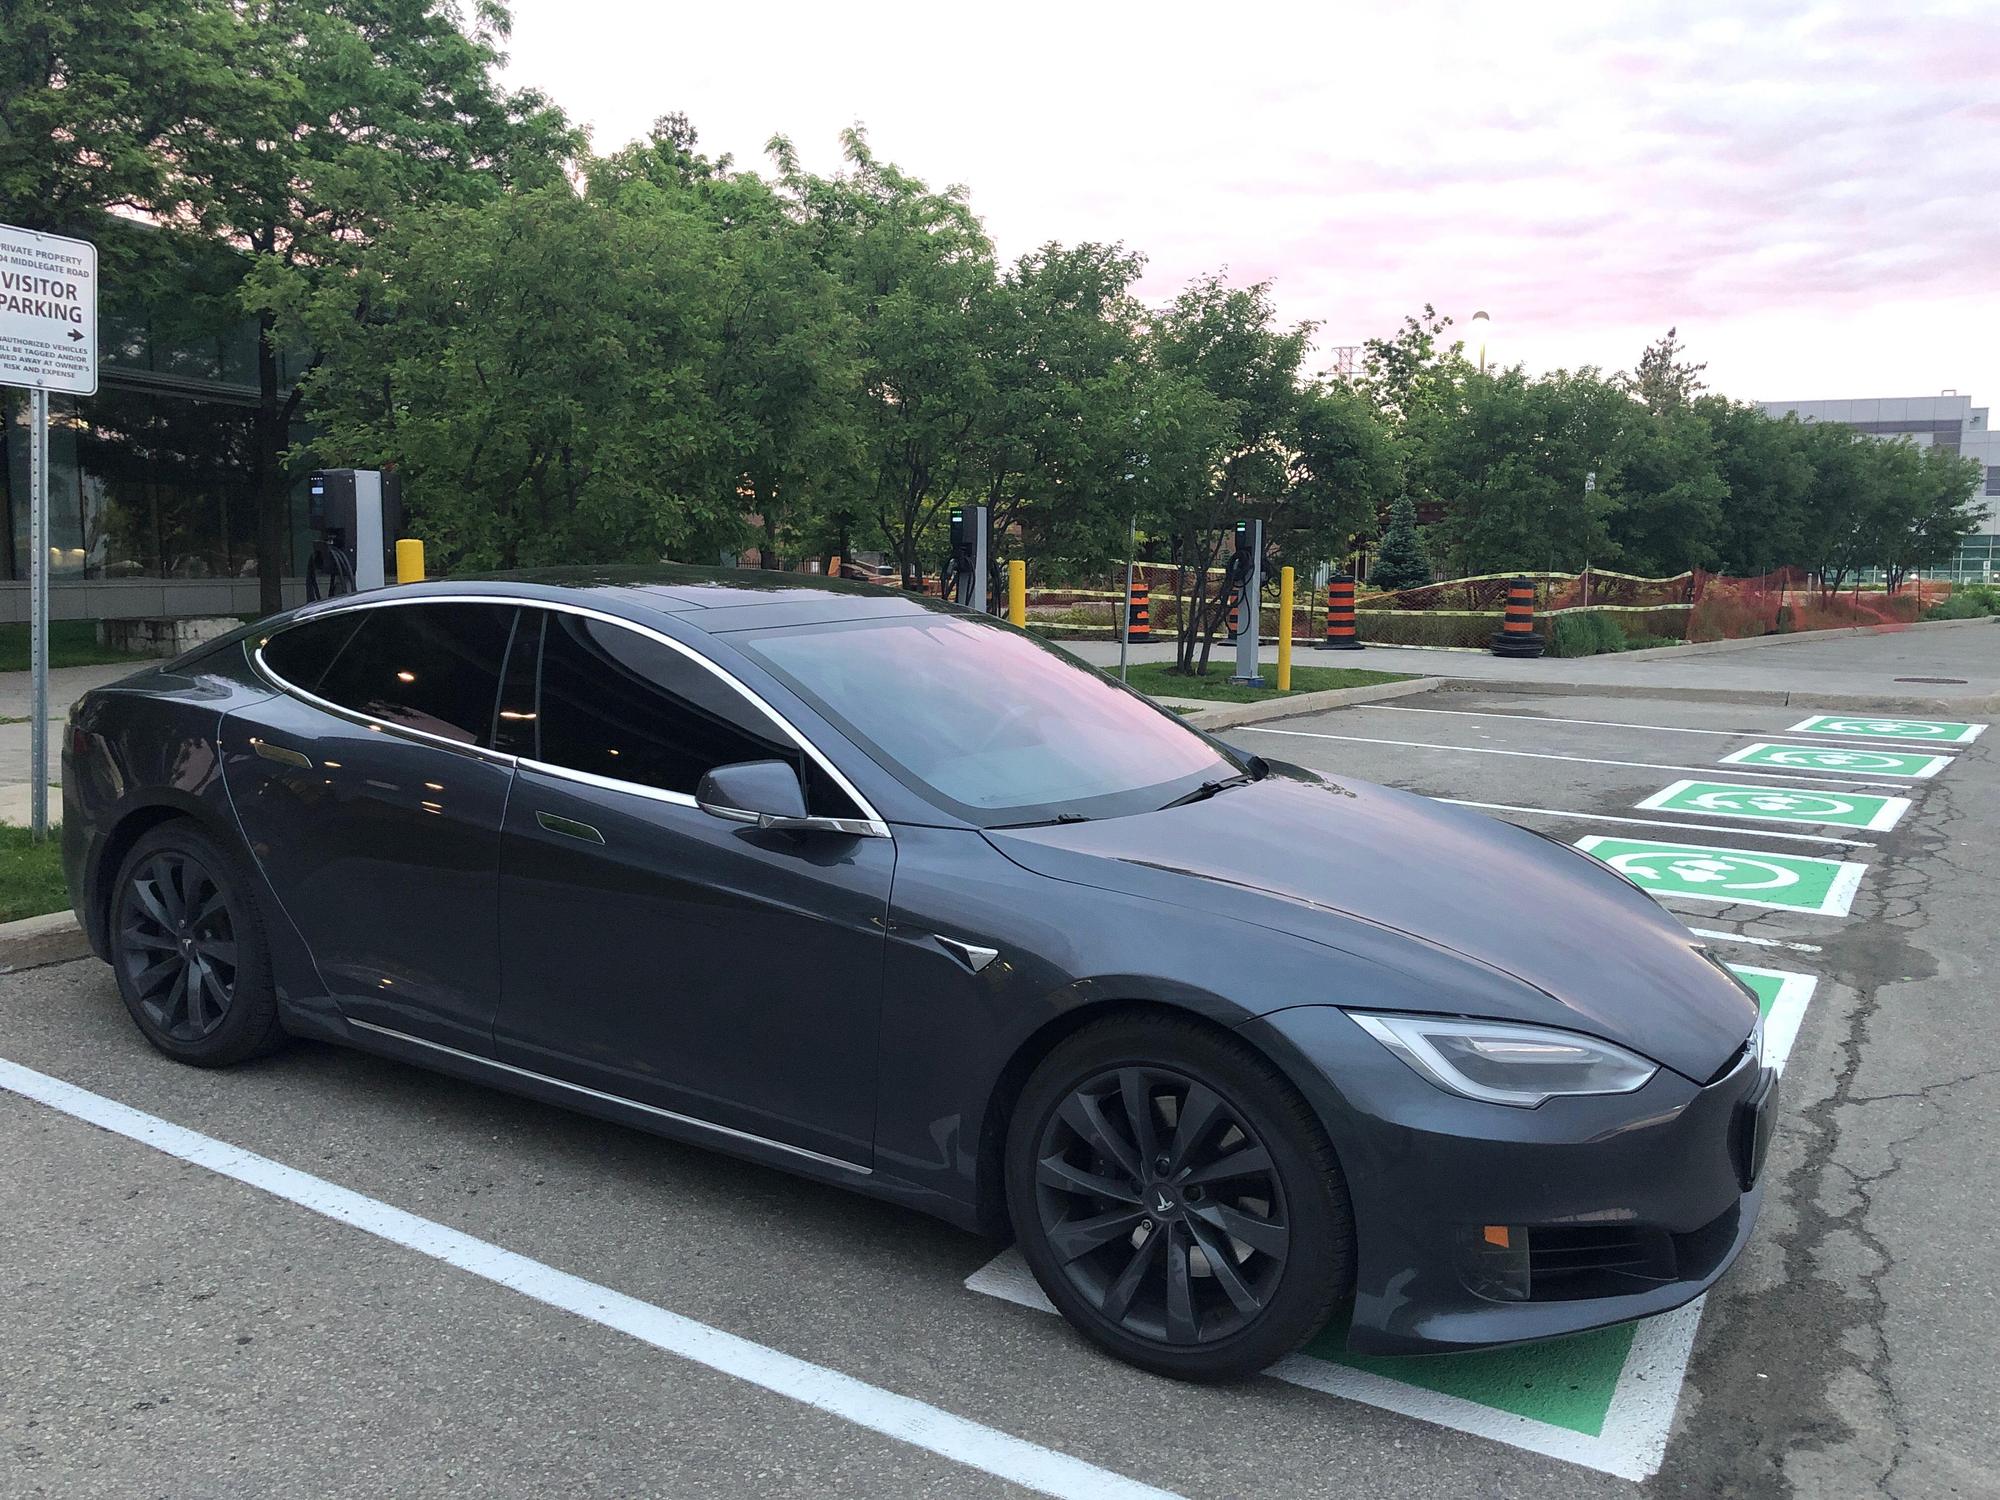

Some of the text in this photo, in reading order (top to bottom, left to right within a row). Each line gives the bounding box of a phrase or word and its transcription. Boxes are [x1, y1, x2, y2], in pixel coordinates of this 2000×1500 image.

[0, 243, 82, 265] RIVATE PROPERTY
[10, 256, 65, 273] MIDDLEGATE
[67, 267, 90, 278] ROAD
[1, 270, 78, 301] VISITOR
[0, 293, 82, 323] PARKING
[24, 348, 55, 358] TAGGED
[57, 353, 87, 363] AND/OR
[52, 343, 88, 354] VEHICLES
[3, 363, 76, 379] RISK AND EXPENSE
[19, 356, 41, 365] AWAY
[44, 359, 53, 367] AT
[55, 361, 90, 372] OWNER'S
